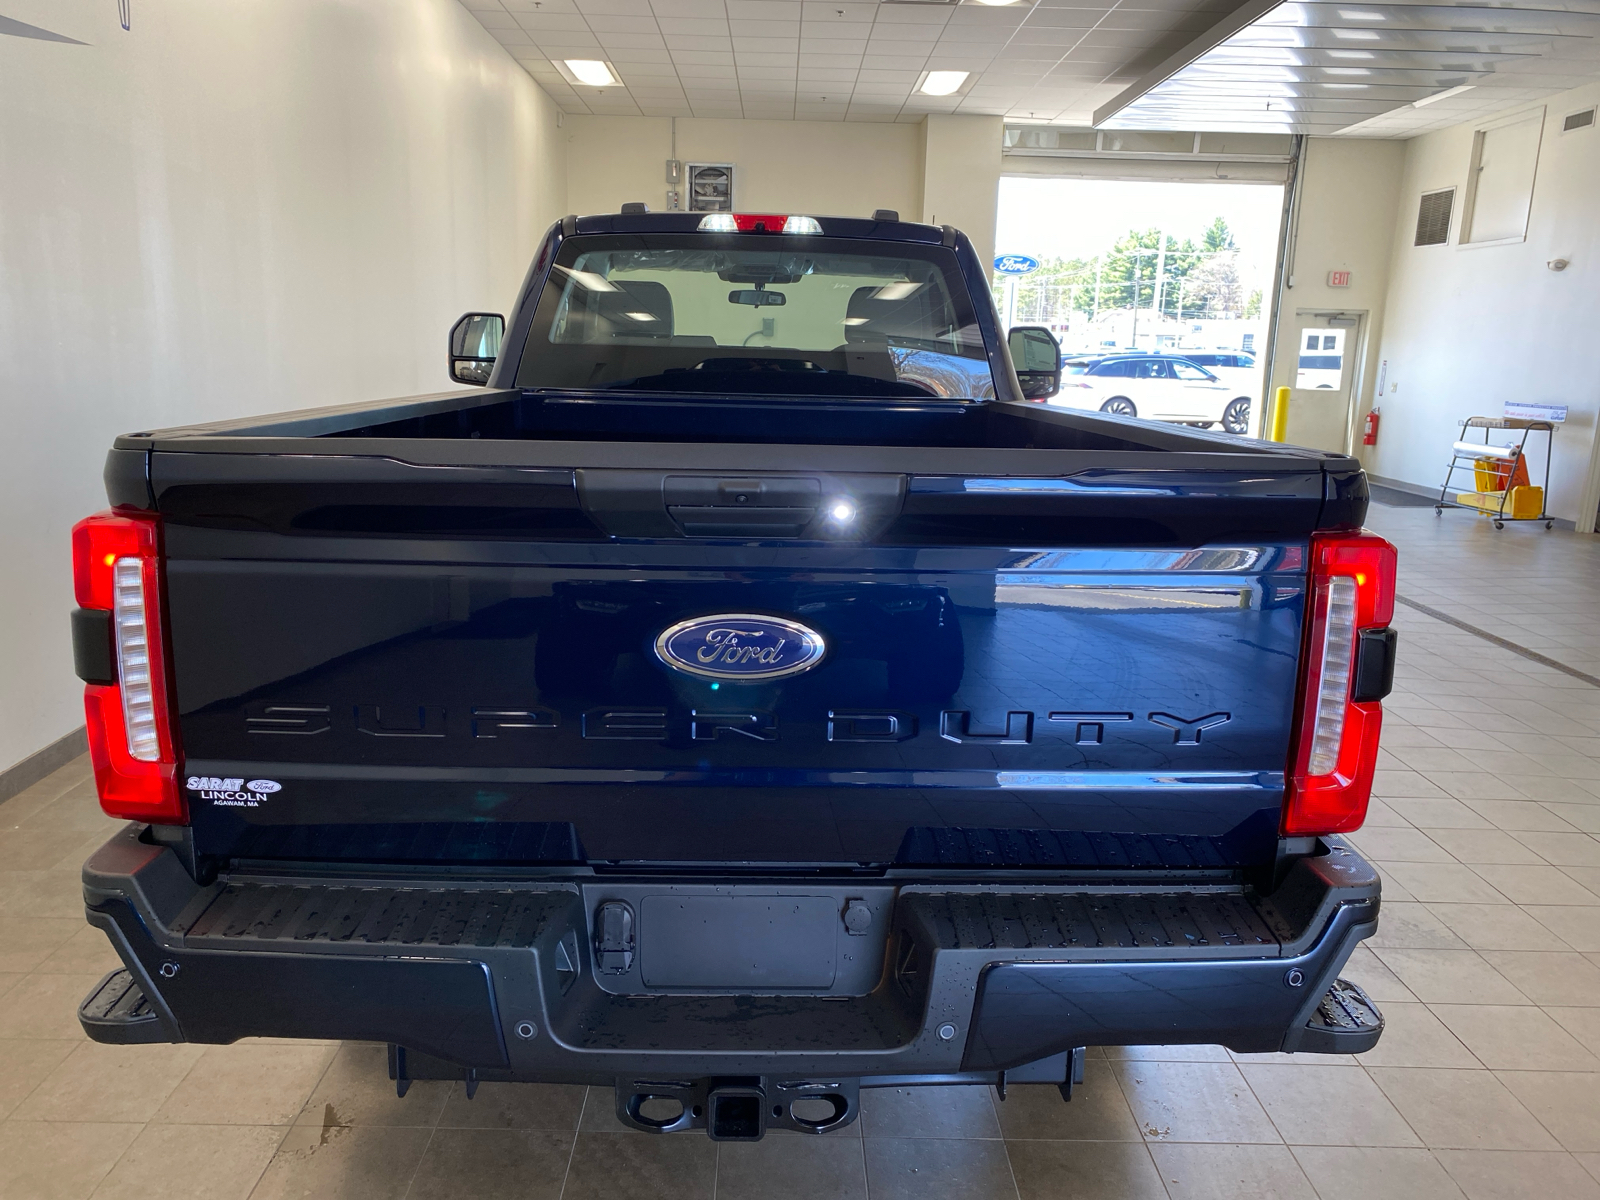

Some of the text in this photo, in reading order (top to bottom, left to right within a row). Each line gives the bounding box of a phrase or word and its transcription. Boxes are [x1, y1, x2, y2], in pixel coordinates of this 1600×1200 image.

[999, 256, 1032, 271] Ford
[1332, 271, 1350, 285] EXIT
[697, 628, 786, 664] Ford
[245, 704, 1232, 746] SUPER DUTY
[187, 776, 244, 792] SARAT
[201, 791, 268, 801] LINCOLN
